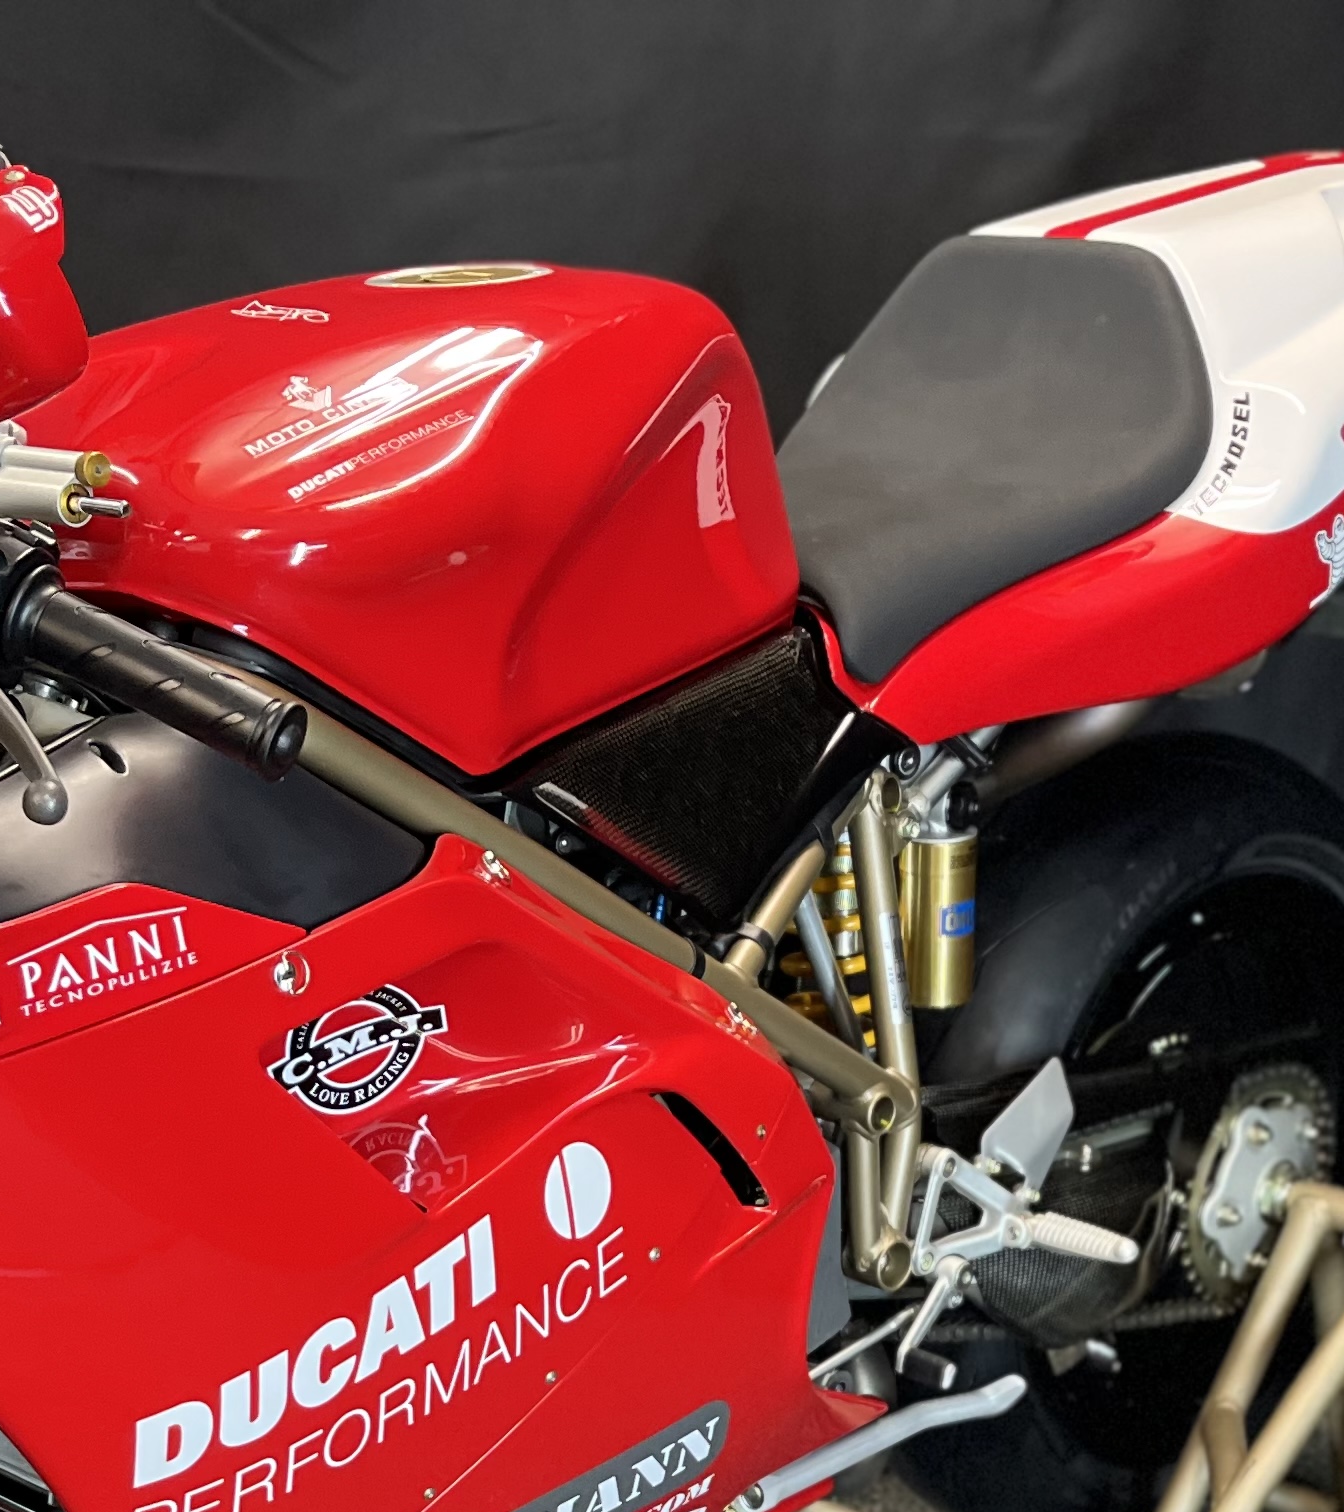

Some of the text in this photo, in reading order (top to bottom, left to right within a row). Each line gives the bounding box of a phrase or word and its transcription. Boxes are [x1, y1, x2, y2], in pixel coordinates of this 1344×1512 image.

[243, 418, 316, 458] MOTO
[1188, 391, 1251, 517] TECNOSEL
[20, 914, 188, 1000] PANNI
[20, 950, 199, 1018] TECNOPULIZIE
[281, 1013, 434, 1085] C.M.J.
[308, 1082, 350, 1106] LOVE
[353, 1051, 410, 1104] RACING
[132, 1213, 497, 1489] DUCATI
